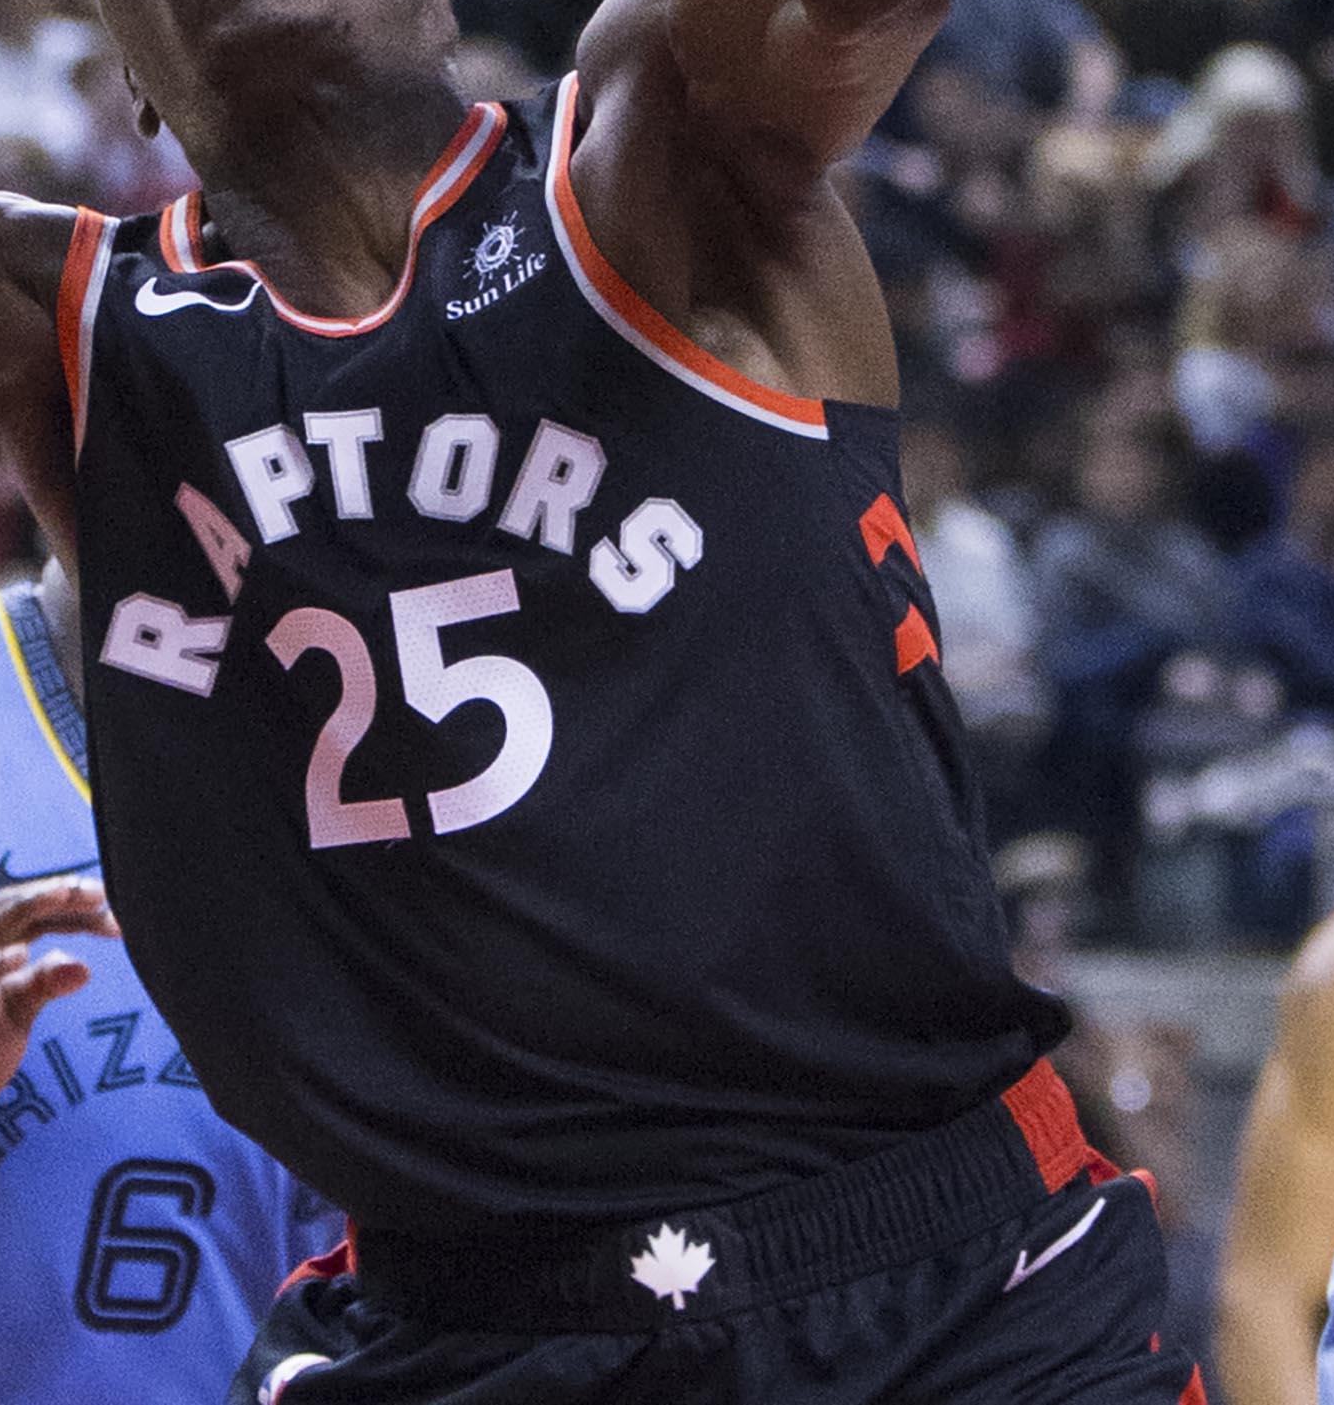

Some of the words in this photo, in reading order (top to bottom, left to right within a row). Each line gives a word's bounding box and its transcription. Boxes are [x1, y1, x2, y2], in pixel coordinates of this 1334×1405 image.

[446, 287, 500, 320] Sun
[503, 252, 547, 294] Life
[100, 408, 704, 698] RAPTORS
[266, 569, 554, 850] 25
[74, 1157, 216, 1335] 6
